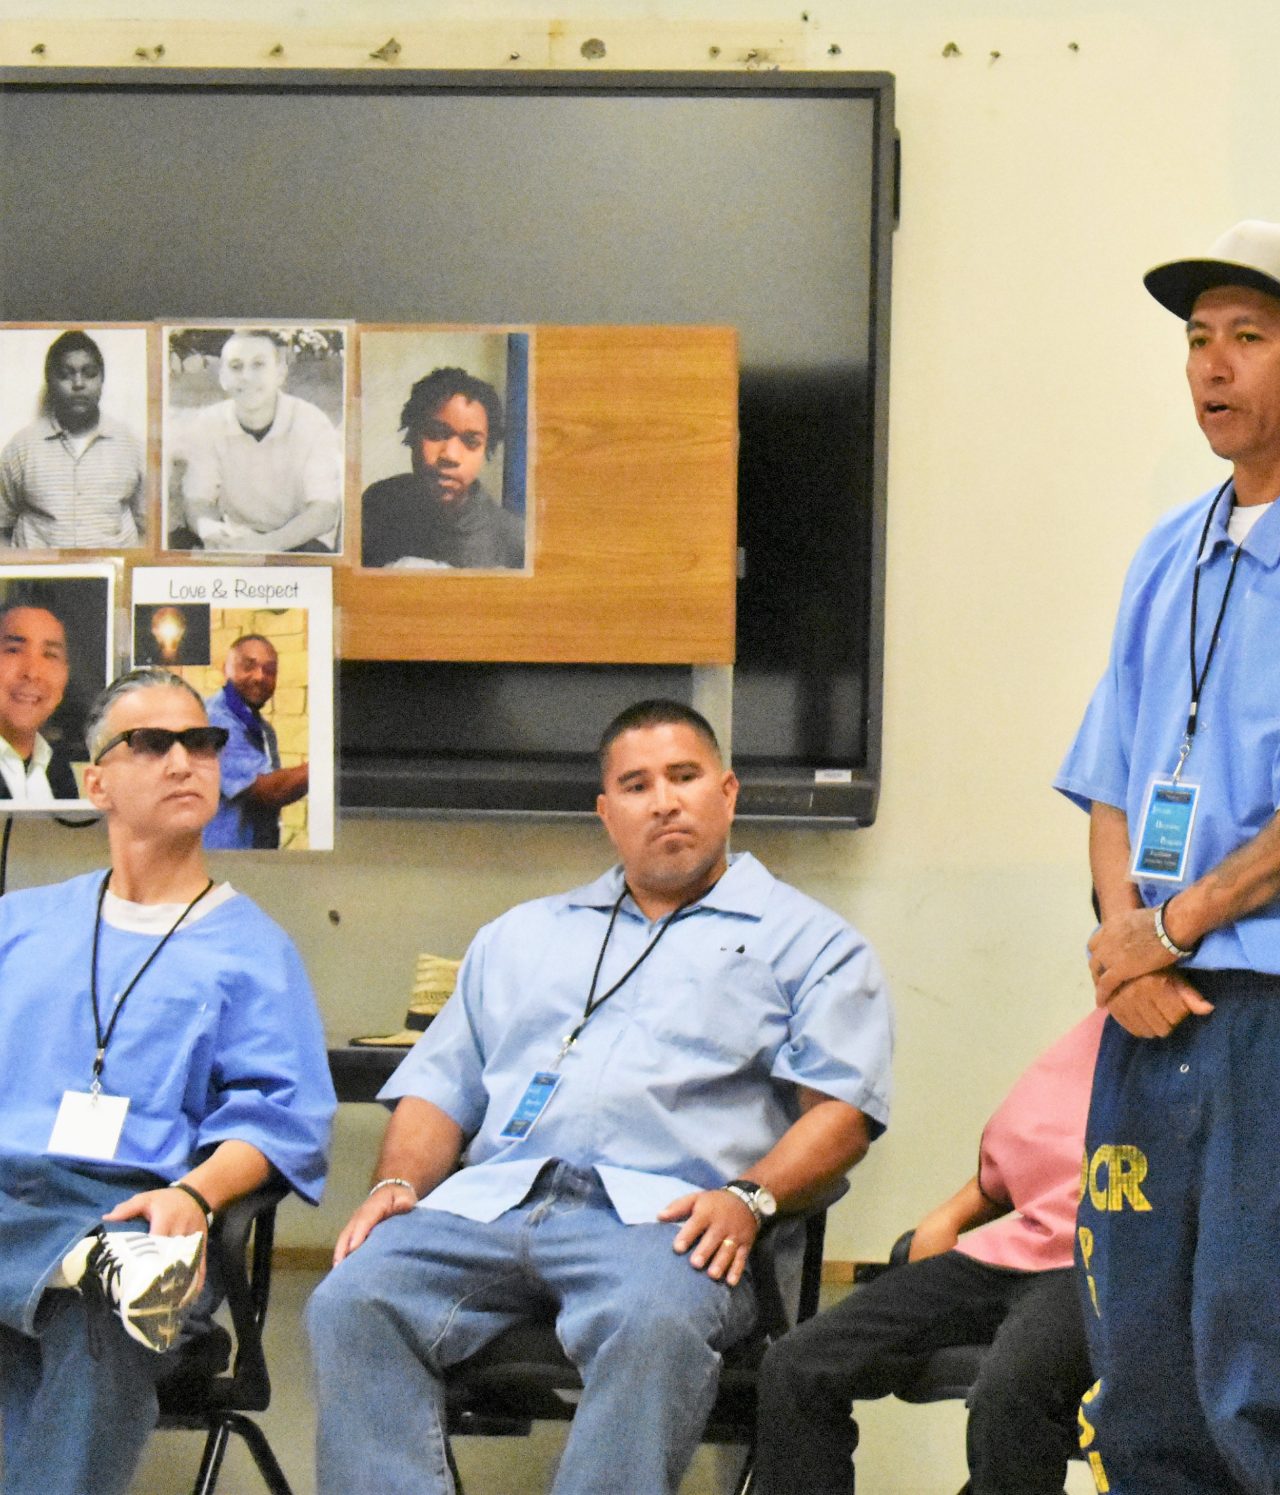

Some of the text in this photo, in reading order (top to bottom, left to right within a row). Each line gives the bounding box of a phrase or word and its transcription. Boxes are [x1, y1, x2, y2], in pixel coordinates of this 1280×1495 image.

[169, 578, 299, 604] Love & Respect
[1079, 1144, 1152, 1211] CR
